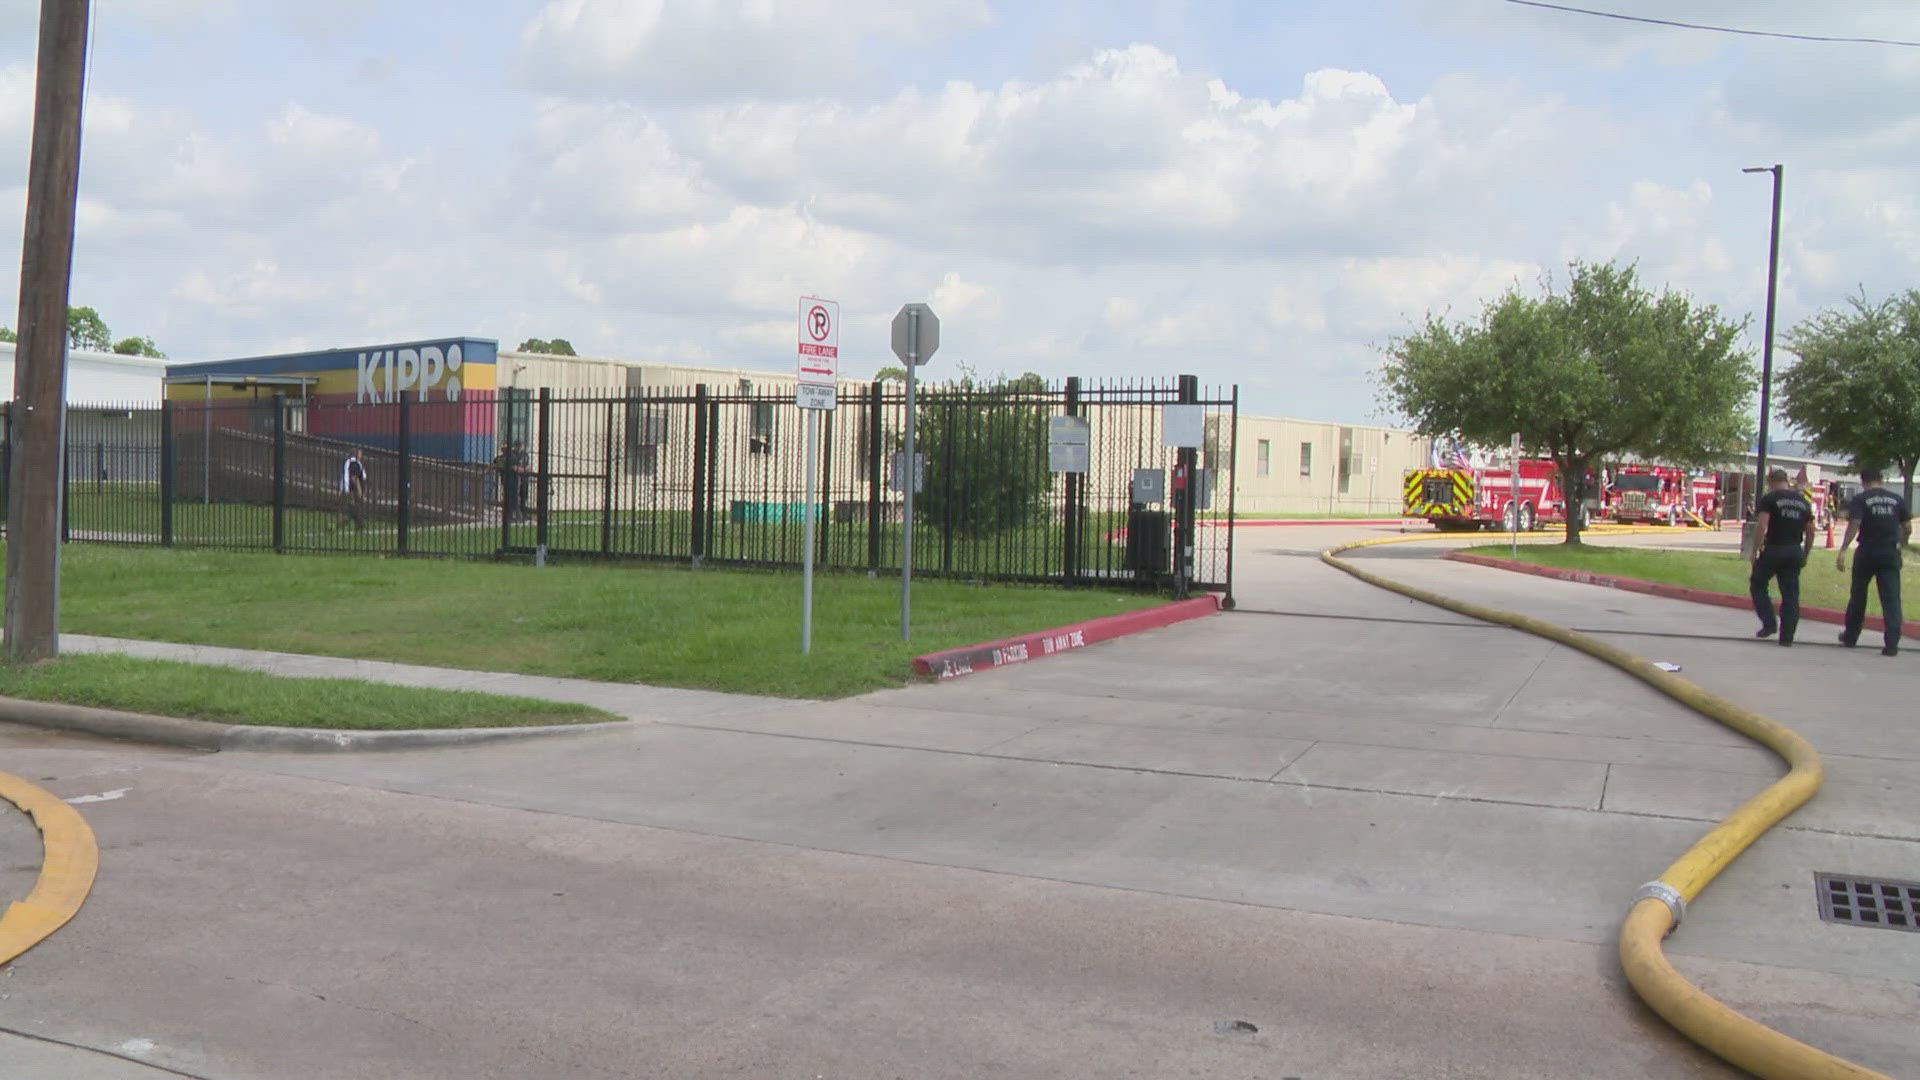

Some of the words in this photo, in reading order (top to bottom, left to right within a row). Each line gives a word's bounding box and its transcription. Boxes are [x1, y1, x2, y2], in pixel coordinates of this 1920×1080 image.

[802, 344, 817, 356] FIRE
[818, 346, 836, 358] LANE
[810, 397, 825, 408] ZONE
[1481, 490, 1491, 508] 34
[1070, 630, 1085, 647] ZONE
